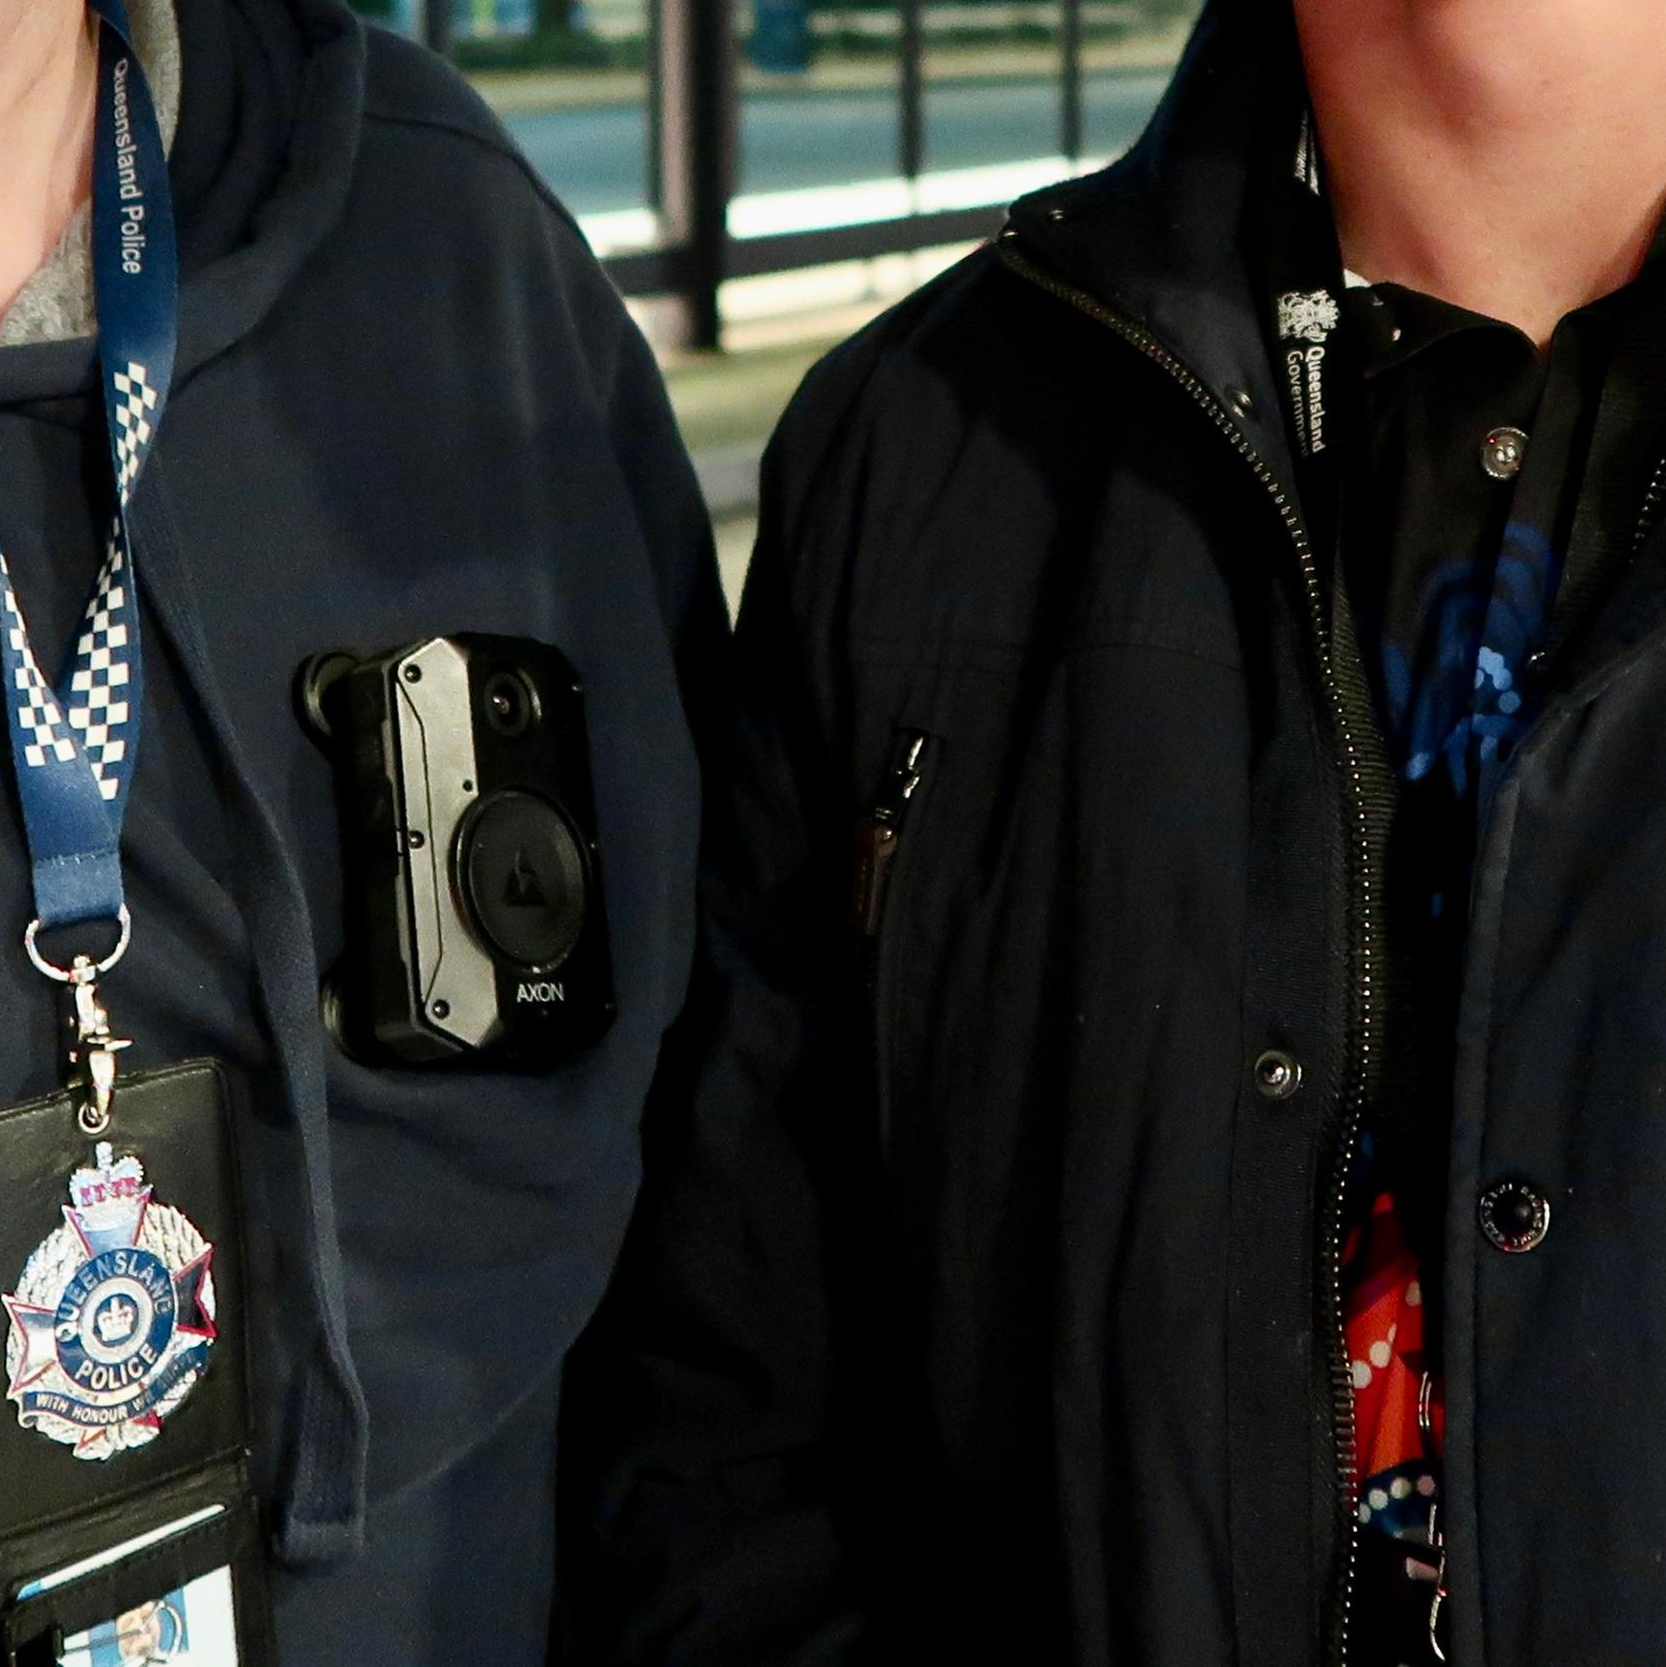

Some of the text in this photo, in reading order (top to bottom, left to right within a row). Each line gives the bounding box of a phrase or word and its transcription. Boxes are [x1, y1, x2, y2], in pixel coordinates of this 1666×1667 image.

[113, 58, 146, 274] Queensland Police
[1305, 346, 1326, 453] Queensland
[517, 982, 564, 1003] AXON
[55, 1251, 171, 1342] QUEENSLAND
[75, 1344, 157, 1390] POLICE
[36, 1394, 68, 1413] WITH
[72, 1405, 129, 1423] HONOUR
